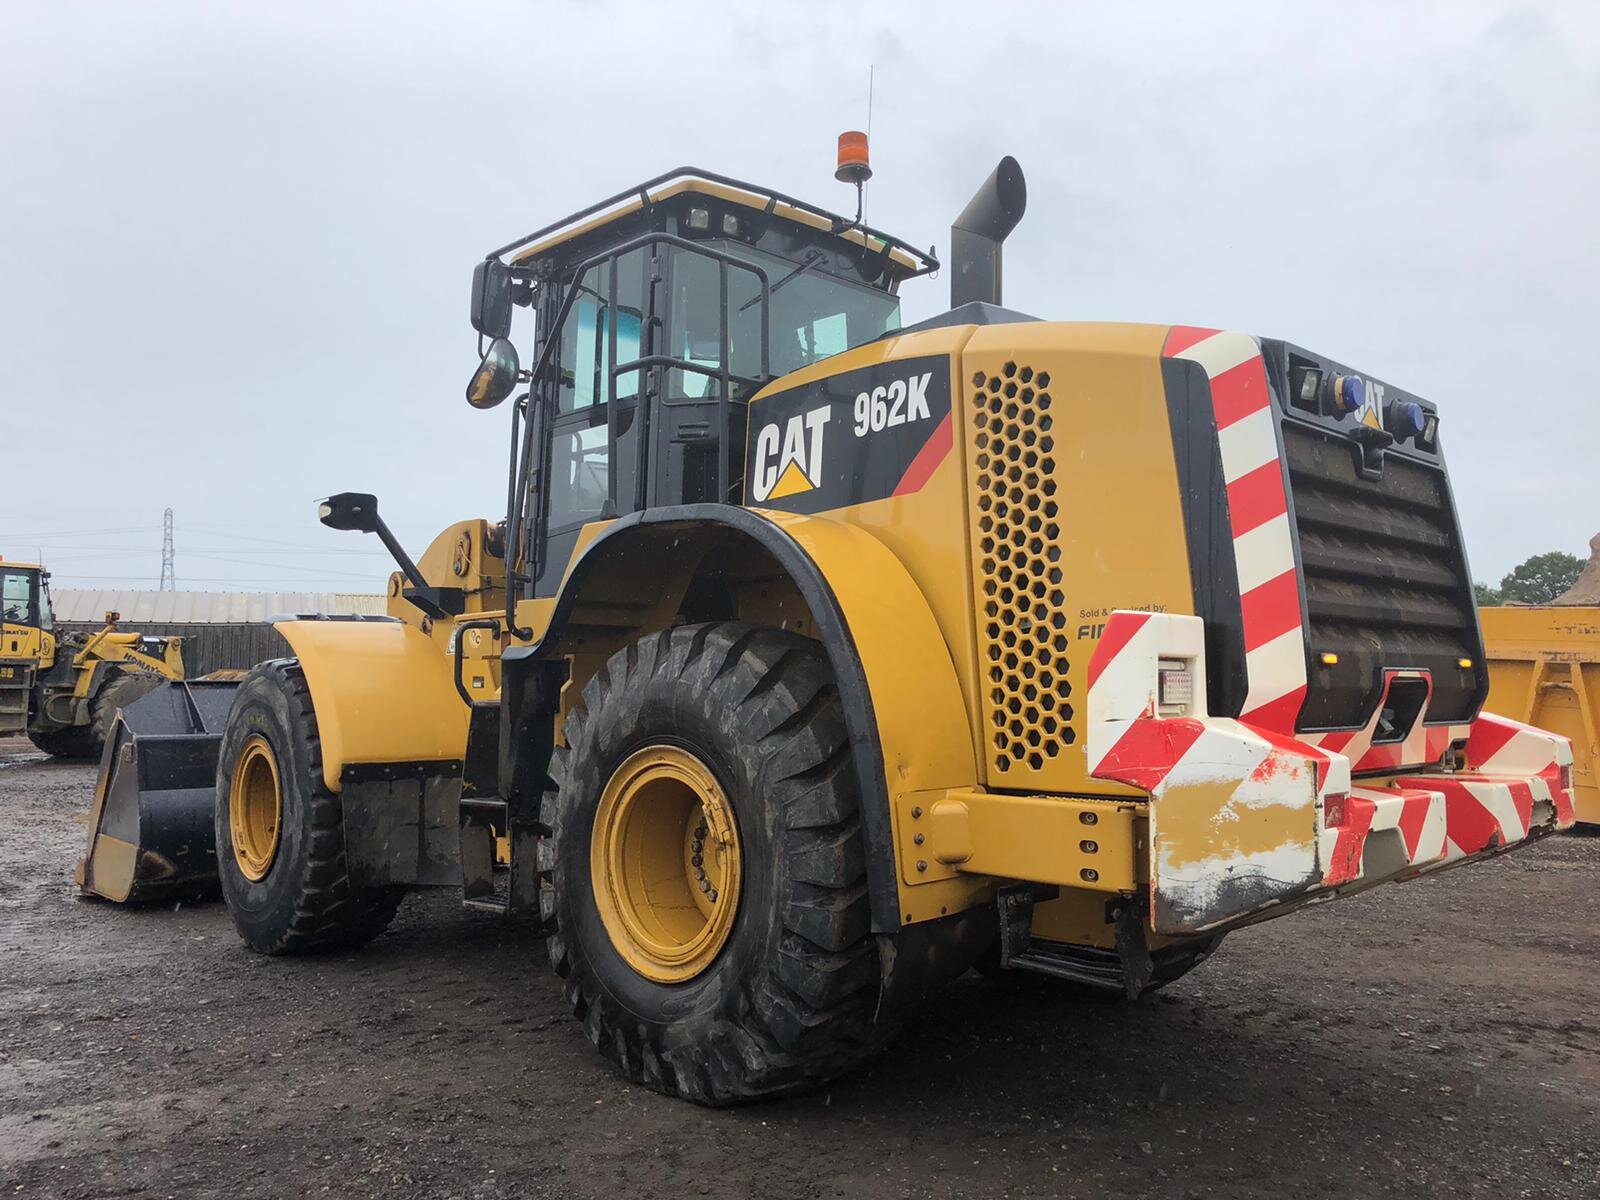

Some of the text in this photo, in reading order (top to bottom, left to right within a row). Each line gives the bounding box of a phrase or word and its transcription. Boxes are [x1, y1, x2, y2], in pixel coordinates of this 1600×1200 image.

[854, 372, 932, 437] 962K
[753, 404, 832, 502] CAT
[1080, 608, 1100, 618] Sold
[1101, 608, 1108, 617] &
[1153, 603, 1168, 613] by:
